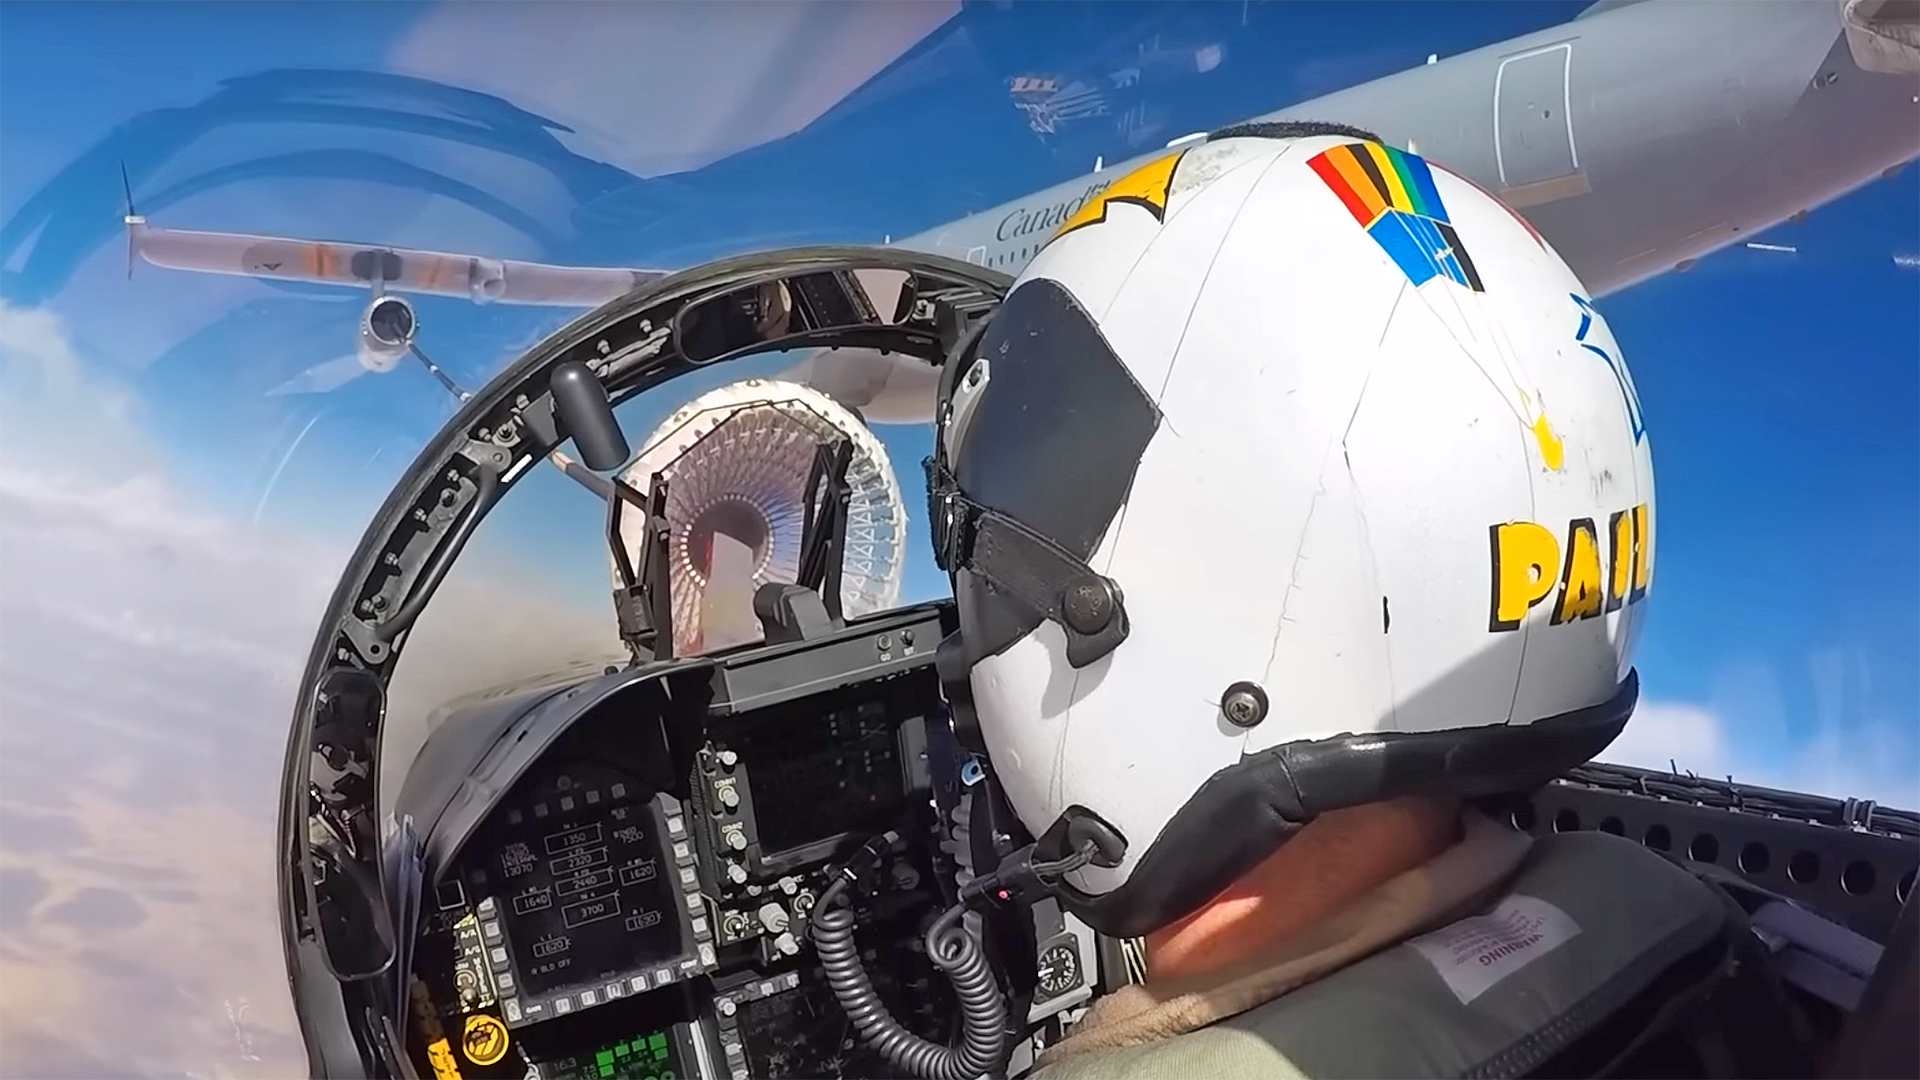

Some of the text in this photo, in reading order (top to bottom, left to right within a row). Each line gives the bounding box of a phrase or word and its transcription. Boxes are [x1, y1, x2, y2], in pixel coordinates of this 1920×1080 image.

[564, 832, 586, 846] 1350
[581, 903, 604, 918] 3700
[1478, 933, 1544, 966] WARNING
